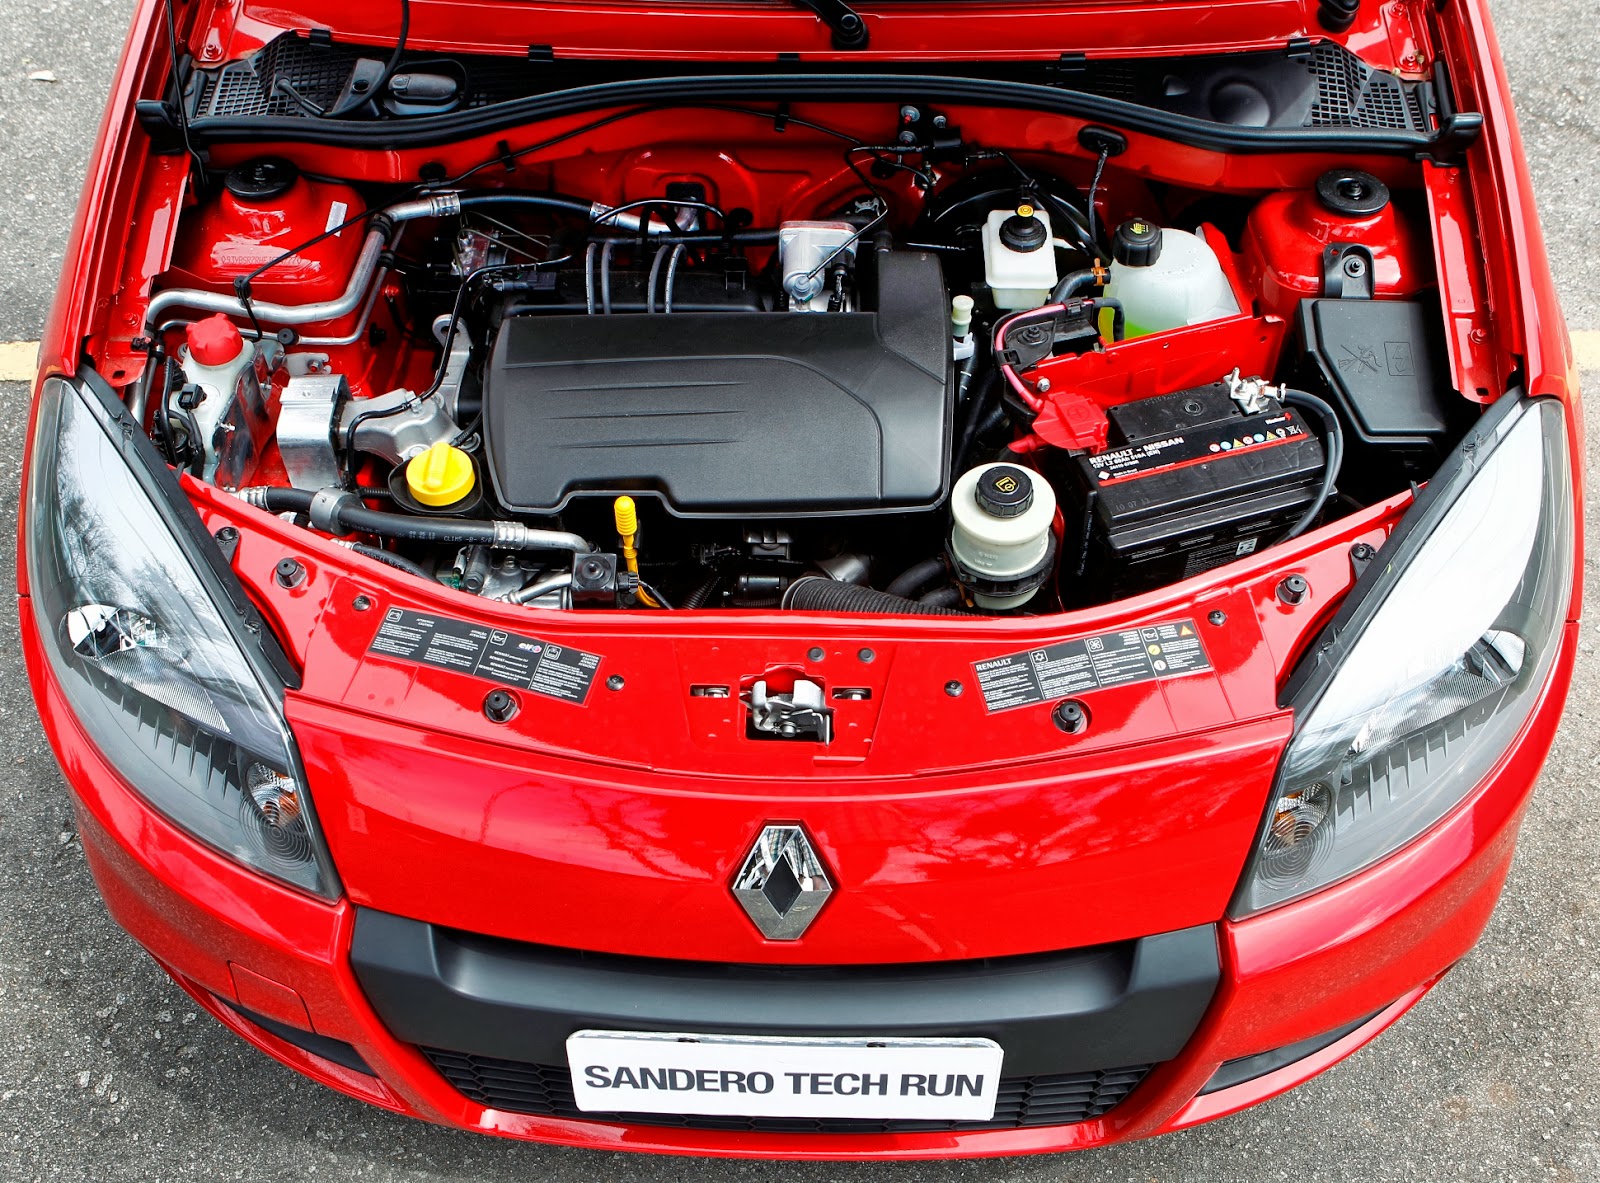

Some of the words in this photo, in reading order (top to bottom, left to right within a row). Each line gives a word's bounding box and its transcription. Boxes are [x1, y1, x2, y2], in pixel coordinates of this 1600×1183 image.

[1089, 448, 1133, 465] RENAULT
[1143, 437, 1185, 452] NISSAN
[975, 657, 1012, 671] RENAULT
[584, 1065, 774, 1094] SANDERO
[785, 1072, 888, 1096] TECH
[899, 1074, 984, 1097] RUN
